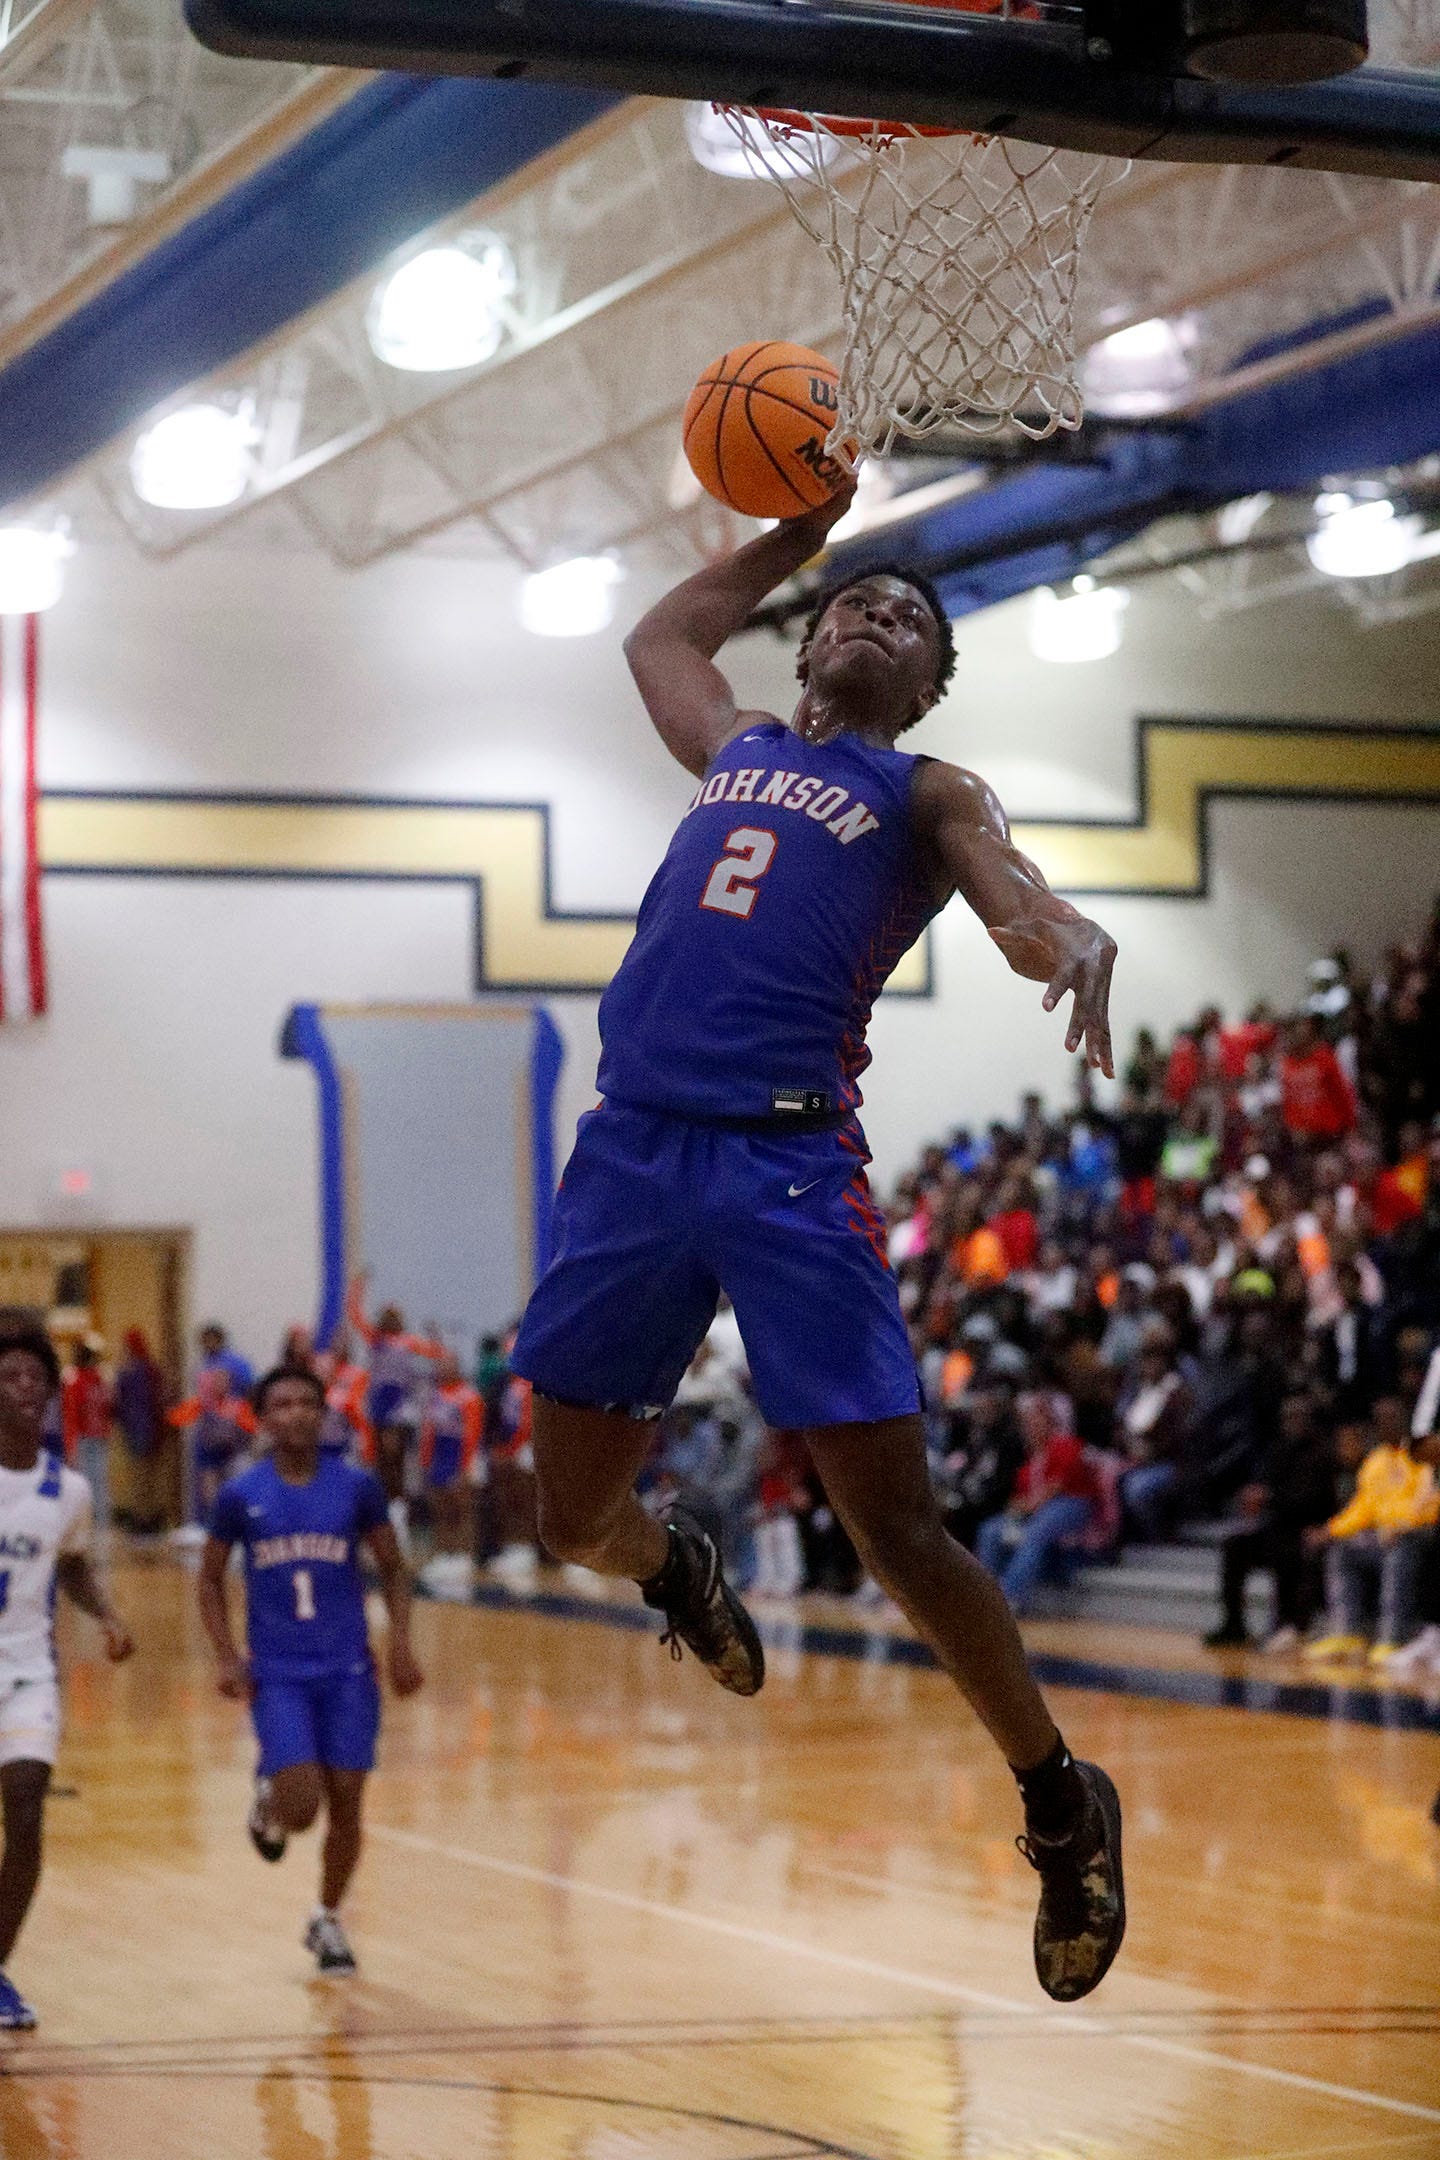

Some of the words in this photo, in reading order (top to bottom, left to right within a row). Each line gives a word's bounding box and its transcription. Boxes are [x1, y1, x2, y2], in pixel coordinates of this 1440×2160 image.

[795, 436, 846, 490] NCA
[684, 768, 880, 846] JOHNSON
[699, 825, 779, 920] 2
[812, 1097, 820, 1108] S
[292, 1569, 316, 1620] 1
